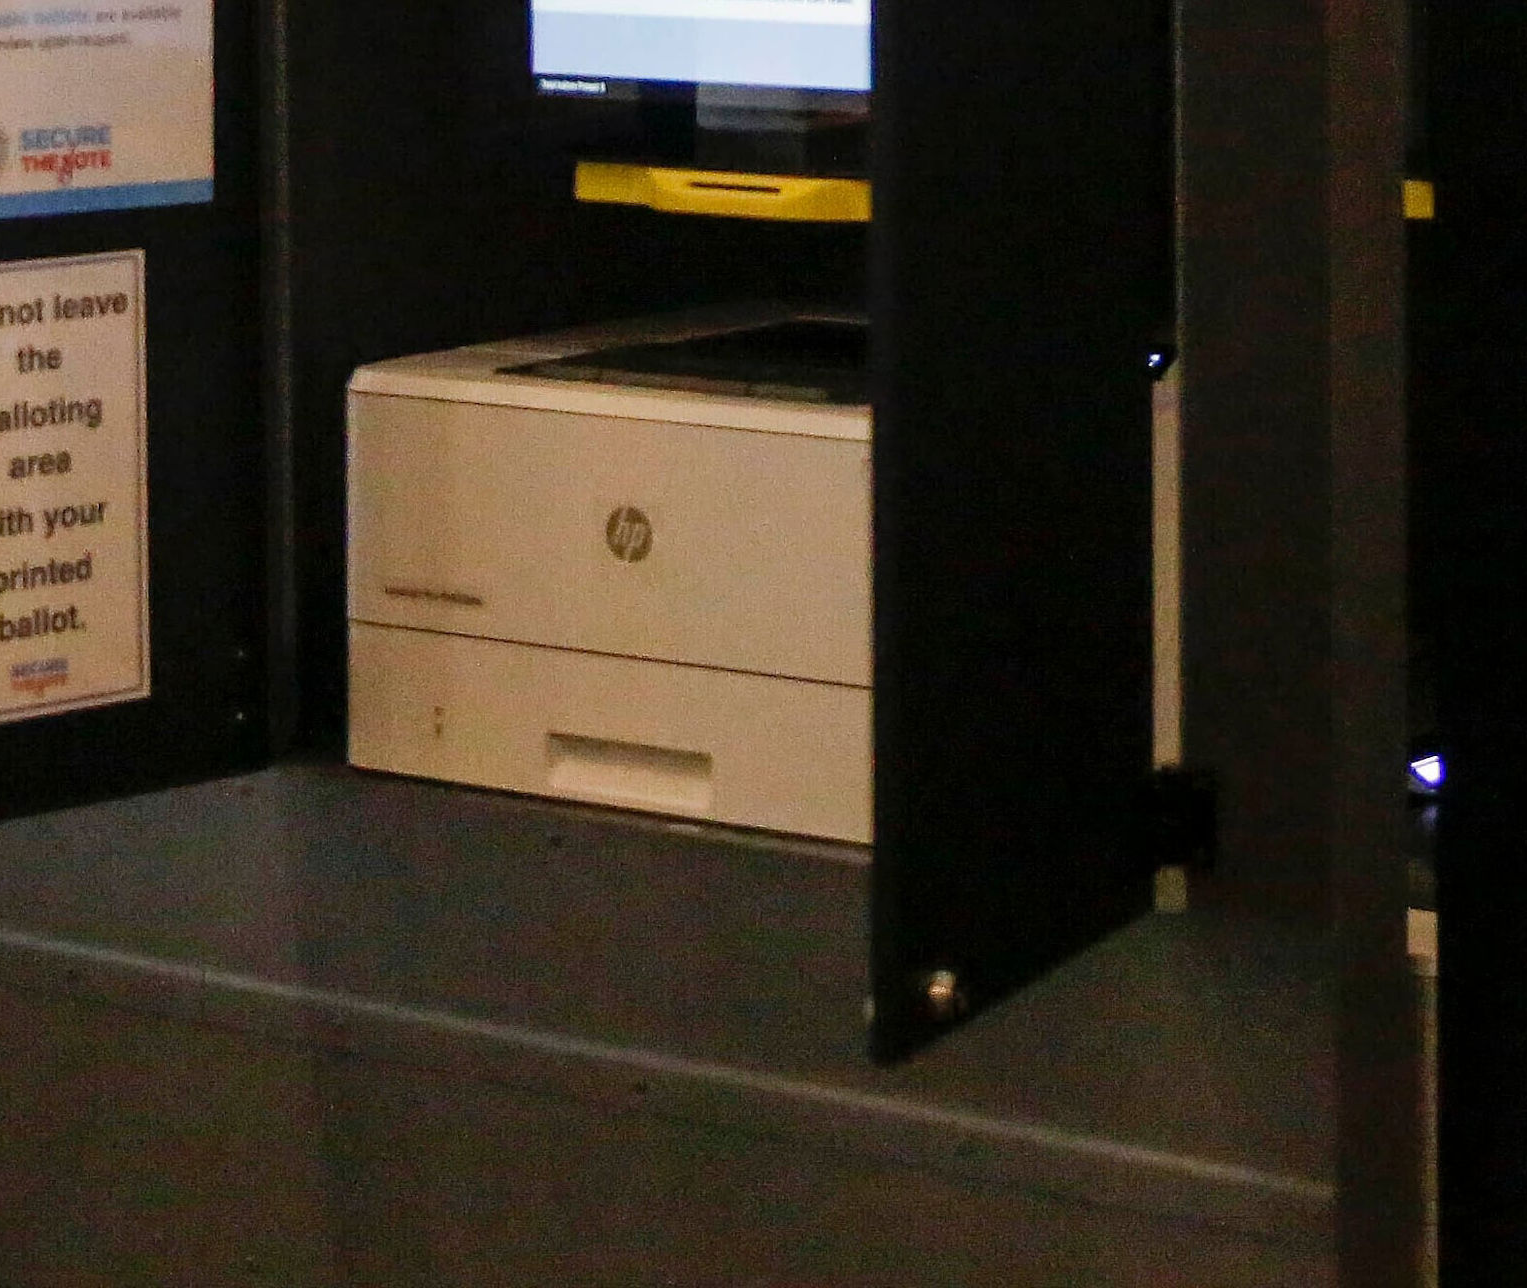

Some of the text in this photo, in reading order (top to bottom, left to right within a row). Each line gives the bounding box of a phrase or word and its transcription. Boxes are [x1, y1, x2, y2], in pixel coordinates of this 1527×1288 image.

[20, 124, 112, 150] SECURE
[53, 292, 128, 320] leave
[17, 345, 62, 374] the
[9, 450, 72, 480] area
[44, 502, 105, 539] your
